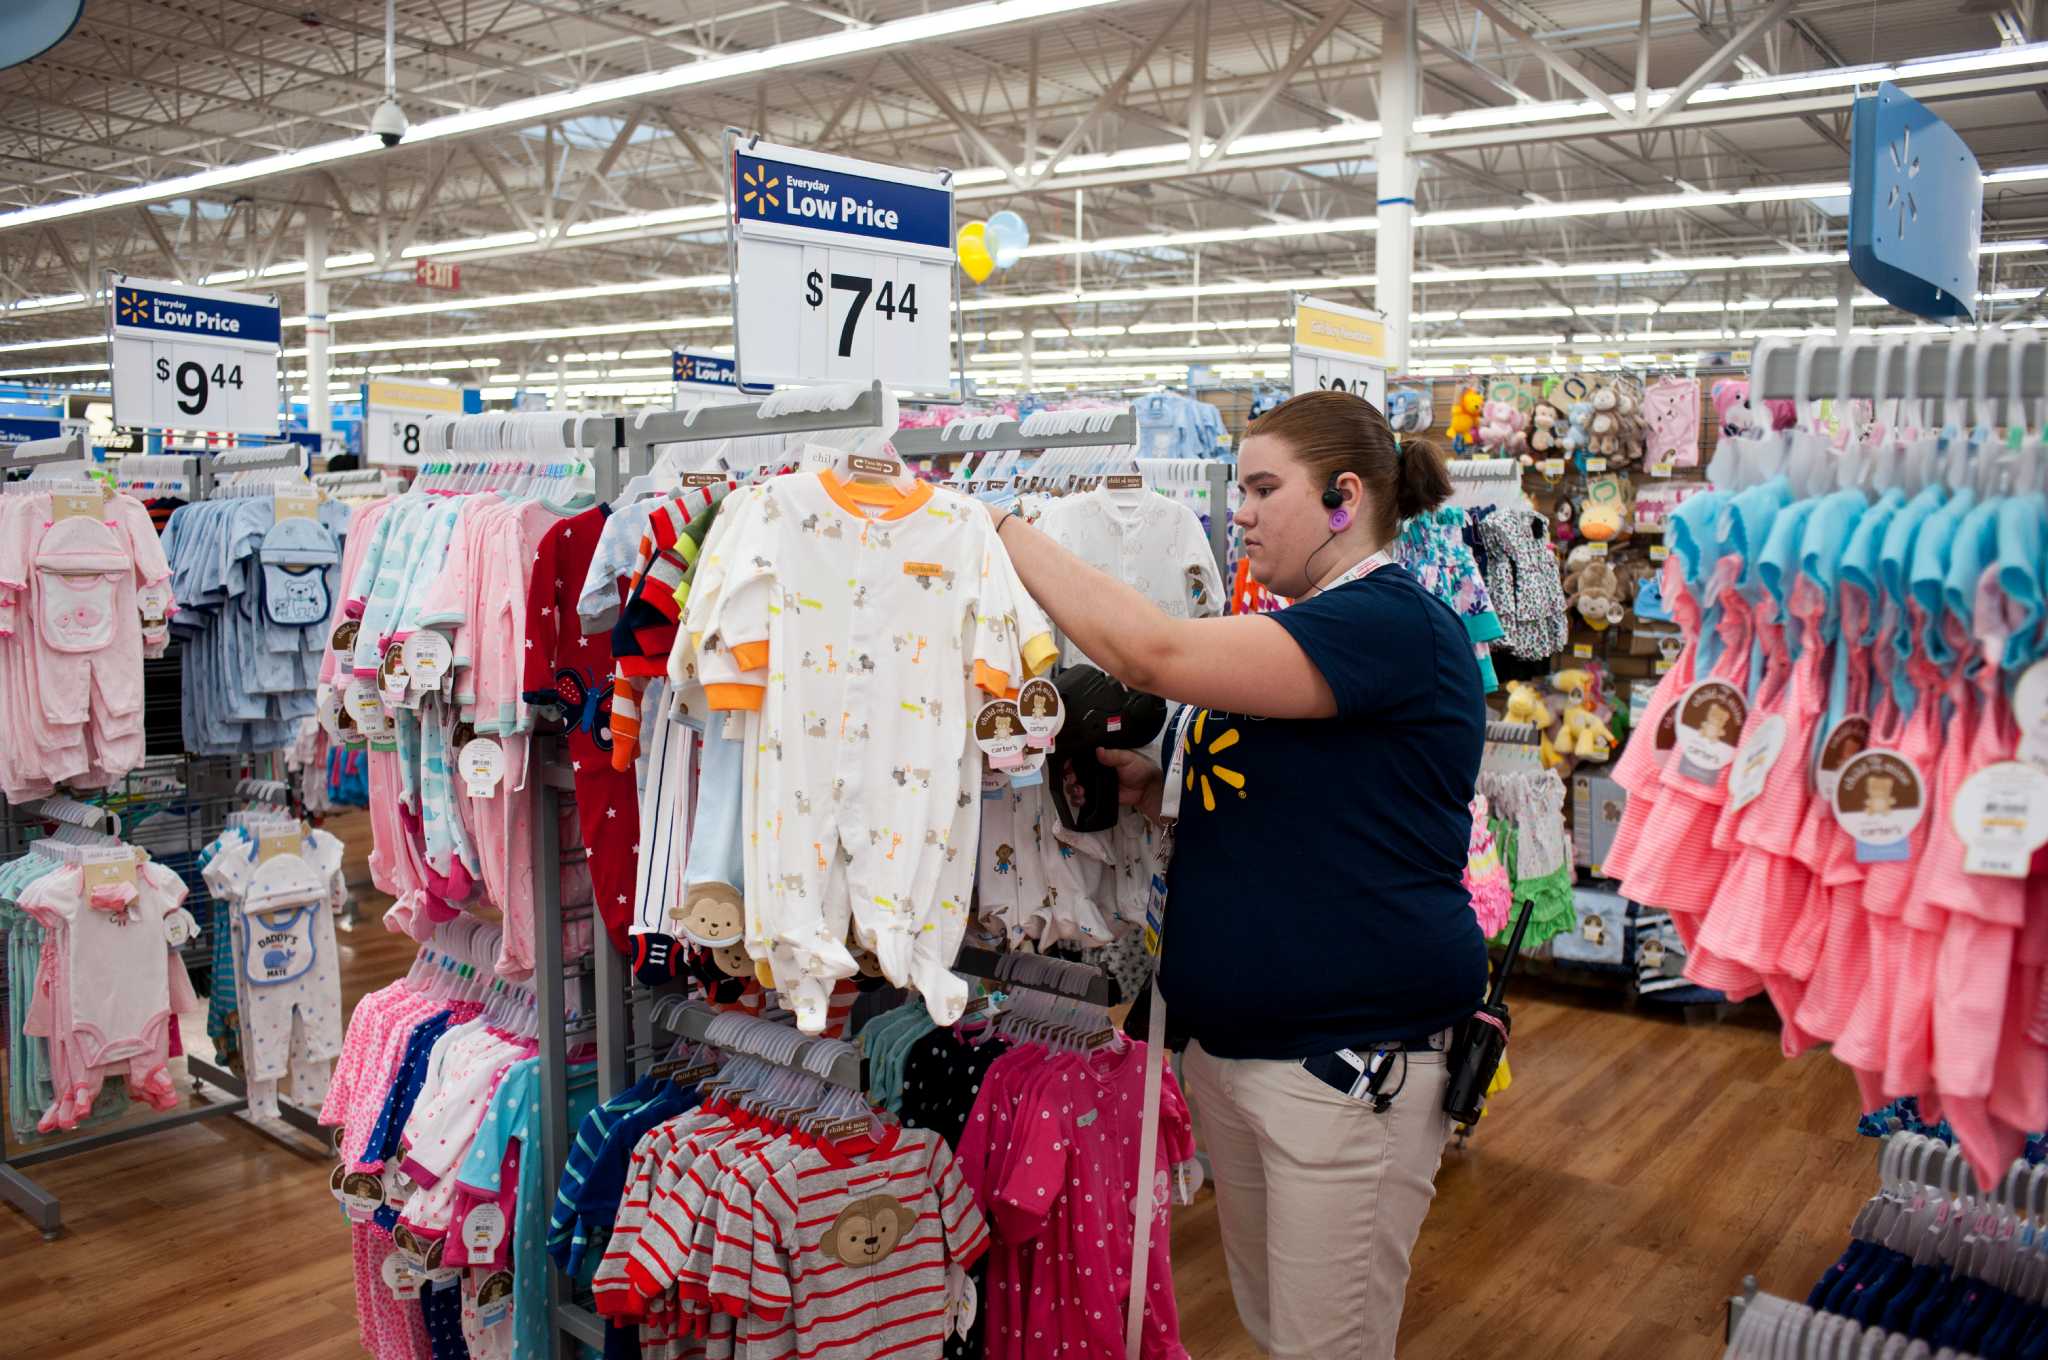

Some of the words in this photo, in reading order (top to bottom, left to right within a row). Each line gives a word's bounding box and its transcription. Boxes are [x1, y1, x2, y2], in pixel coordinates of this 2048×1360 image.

[786, 175, 830, 195] Everyday
[786, 187, 838, 221] Low
[841, 196, 899, 230] Price
[425, 262, 453, 289] EXIT
[154, 297, 187, 311] Everyday
[154, 306, 192, 328] Low
[195, 311, 241, 333] Price
[695, 365, 720, 381] Low
[720, 368, 737, 383] Pri
[812, 451, 832, 464] chil
[1023, 685, 1036, 702] child
[981, 708, 997, 726] child
[1029, 725, 1049, 733] carter's
[991, 744, 1018, 754] carter's
[1011, 763, 1036, 773] carter's
[257, 934, 298, 949] DADDY'S
[266, 968, 287, 977] MATE
[829, 1125, 845, 1135] child
[853, 1120, 869, 1129] mine
